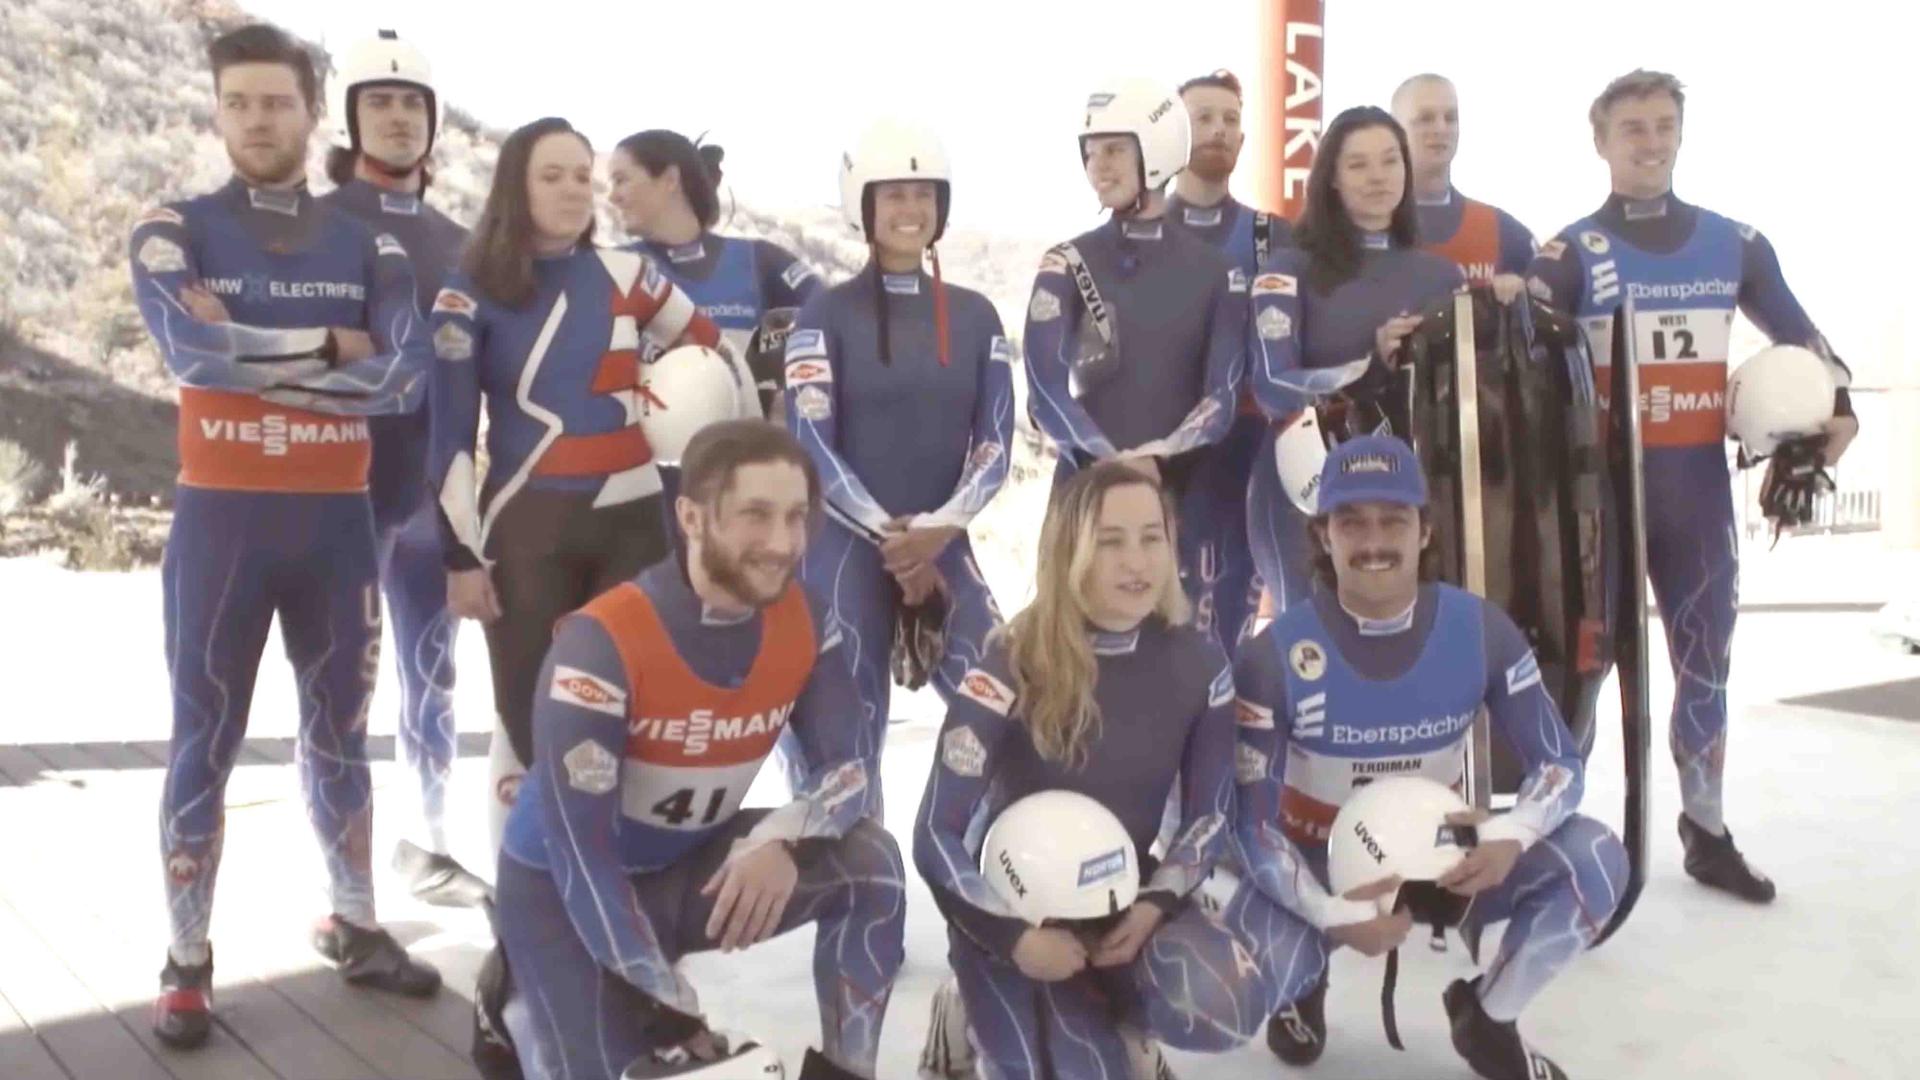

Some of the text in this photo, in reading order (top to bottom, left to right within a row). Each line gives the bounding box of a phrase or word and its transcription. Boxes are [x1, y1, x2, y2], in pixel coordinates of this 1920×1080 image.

[1284, 22, 1323, 199] LAKE
[1658, 314, 1688, 327] WEST
[1652, 330, 1698, 360] 12
[1352, 758, 1422, 774] TERDIMAN
[651, 786, 727, 825] 41
[1354, 820, 1388, 865] uvex
[999, 849, 1028, 899] uvex
